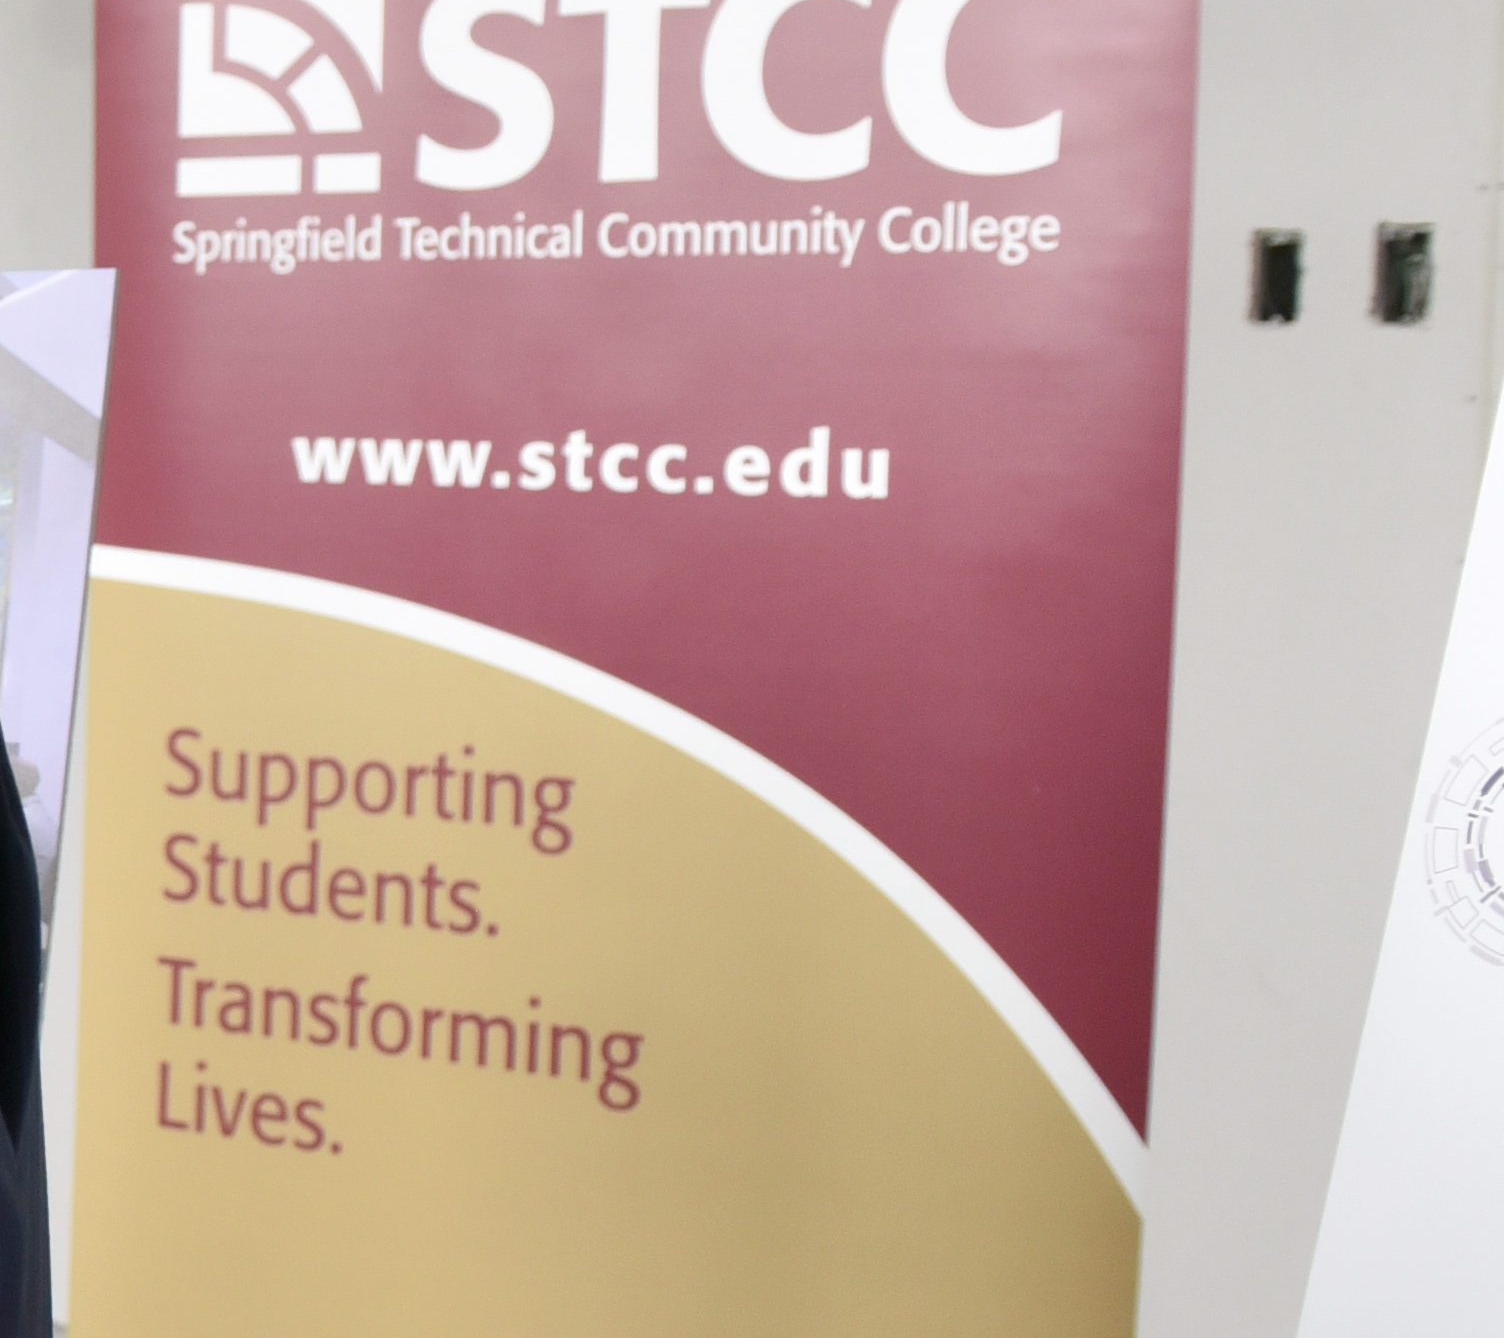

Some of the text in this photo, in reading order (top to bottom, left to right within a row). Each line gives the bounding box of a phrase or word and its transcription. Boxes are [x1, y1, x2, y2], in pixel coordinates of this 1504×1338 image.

[171, 200, 1063, 275] Springfield Technical Community College
[290, 424, 891, 501] www.stcc.edu
[165, 726, 576, 856] Supporting
[162, 832, 500, 938] Students.
[156, 955, 646, 1114] Transforming
[157, 1060, 344, 1156] Lives.
